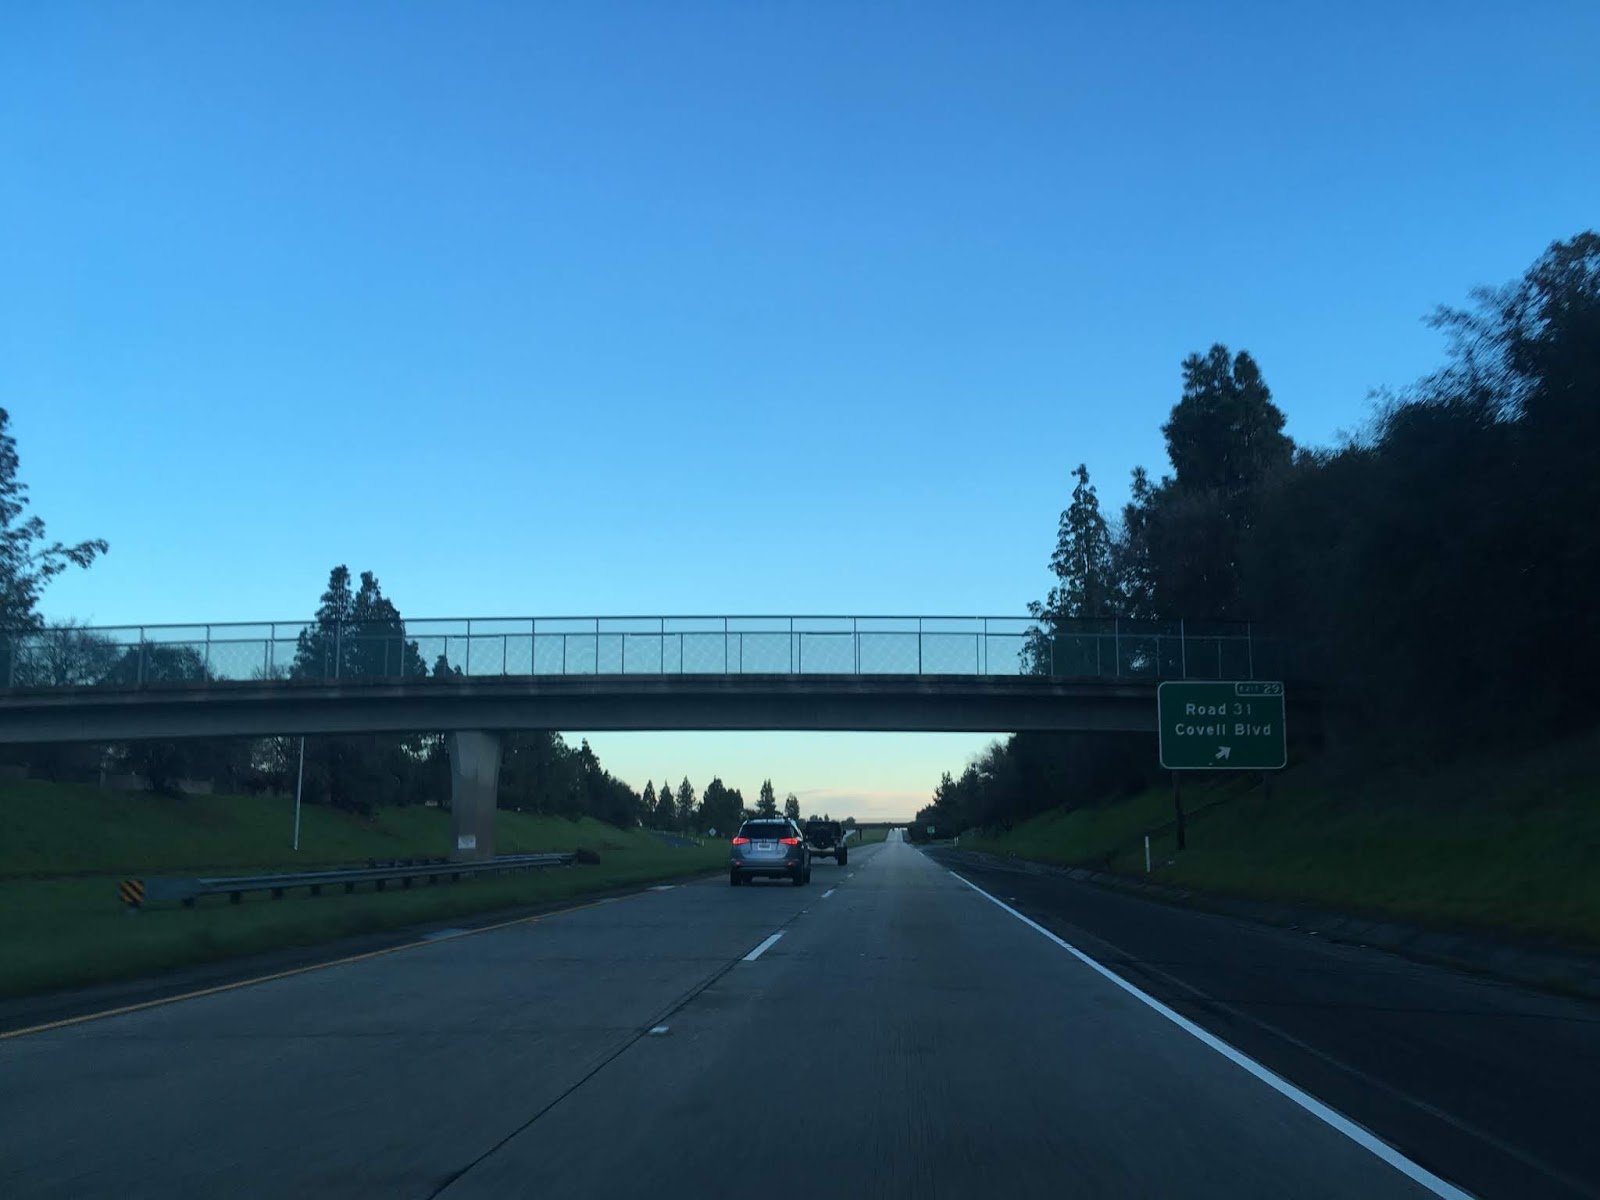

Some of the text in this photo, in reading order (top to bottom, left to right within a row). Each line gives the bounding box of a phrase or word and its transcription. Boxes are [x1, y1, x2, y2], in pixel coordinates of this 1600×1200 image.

[1239, 684, 1280, 694] EXIT 29
[1186, 703, 1251, 715] Road 31
[1175, 723, 1271, 736] Covell Blvd
